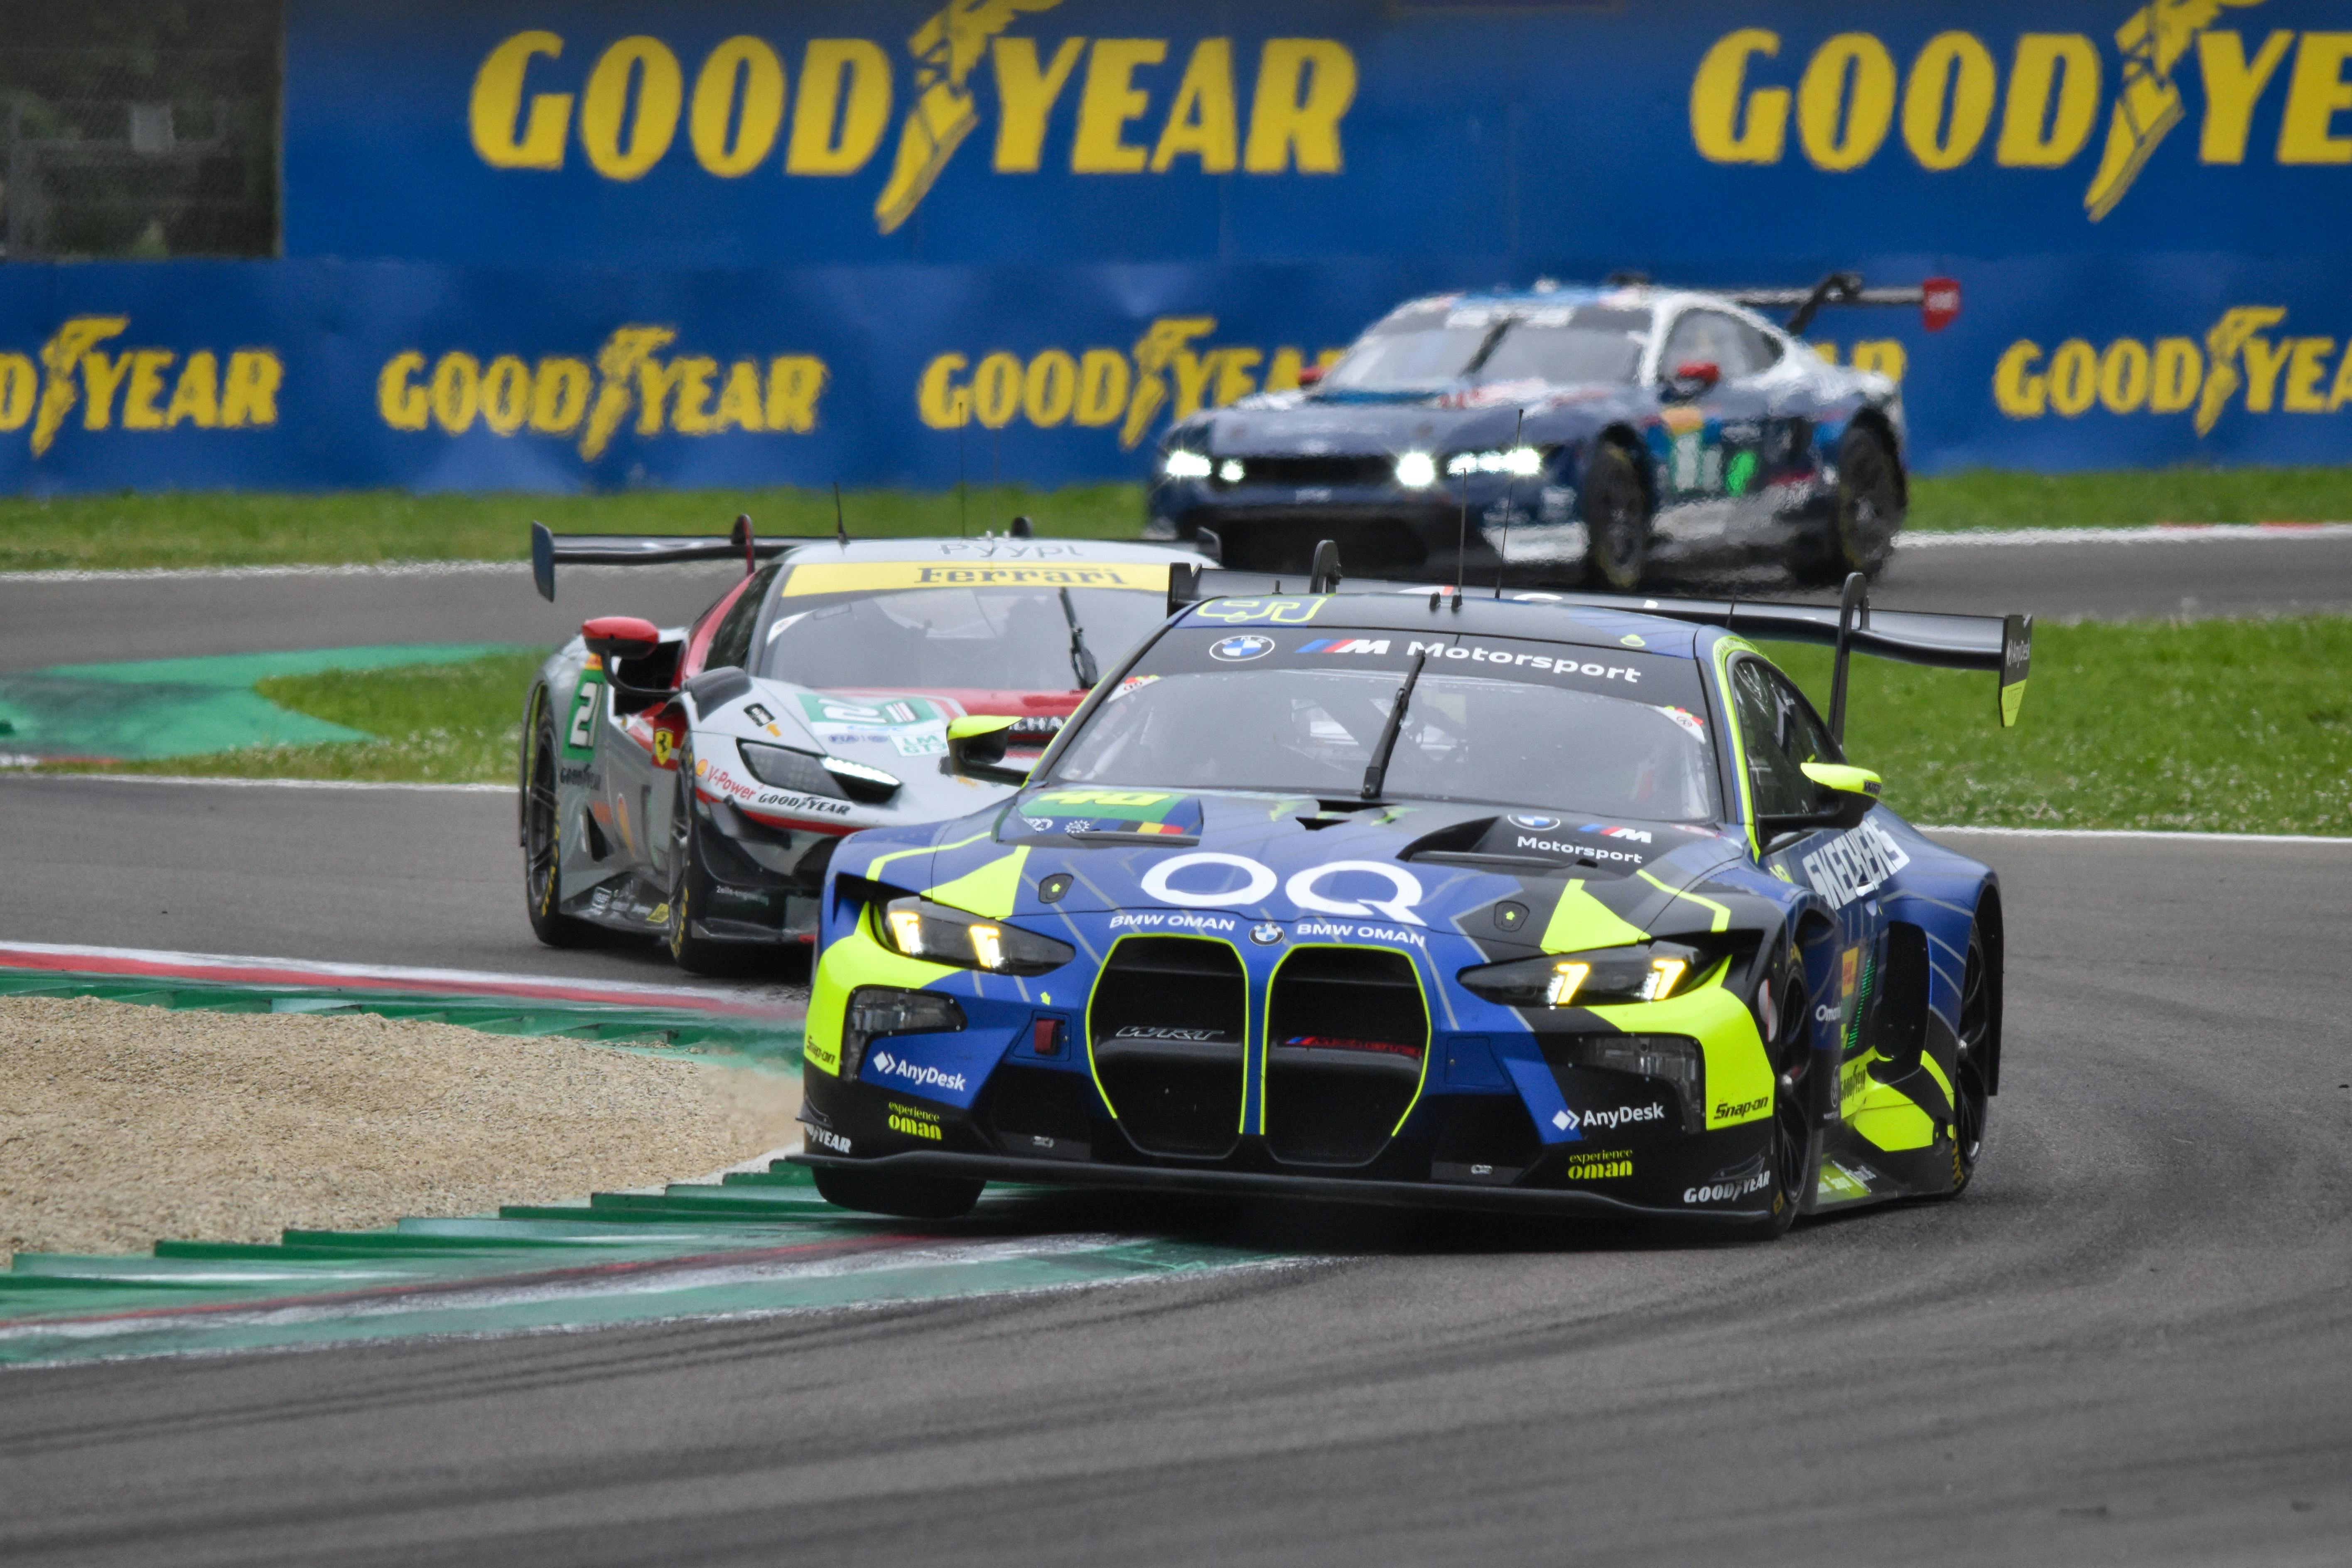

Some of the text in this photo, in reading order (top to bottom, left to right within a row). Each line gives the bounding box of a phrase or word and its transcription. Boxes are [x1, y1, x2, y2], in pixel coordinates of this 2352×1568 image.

[469, 28, 1358, 181] GOODYEAR
[377, 350, 829, 435] GOODYEAR
[917, 348, 1347, 430] GOODYE
[914, 567, 1128, 585] Ferrari
[1407, 640, 1641, 683] Motorsport
[1009, 716, 1070, 731] CHA
[707, 766, 757, 800] V-Power
[758, 793, 852, 815] GOODYEAR
[1517, 836, 1642, 864] Motorsport
[1141, 852, 1427, 926] OQ
[1110, 914, 1235, 931] BMW OMAN
[1297, 924, 1425, 948] BMW OMAN
[1116, 1026, 1225, 1041] WRT
[896, 1062, 966, 1092] AnyDesk
[889, 1101, 940, 1123] experience
[1583, 1102, 1665, 1129] AnyDesk
[1714, 1096, 1768, 1120] Snap-on
[888, 1114, 942, 1141] oman
[1569, 1149, 1633, 1163] experience
[1568, 1160, 1633, 1180] oman
[1684, 1170, 1770, 1203] GOODYEAR
